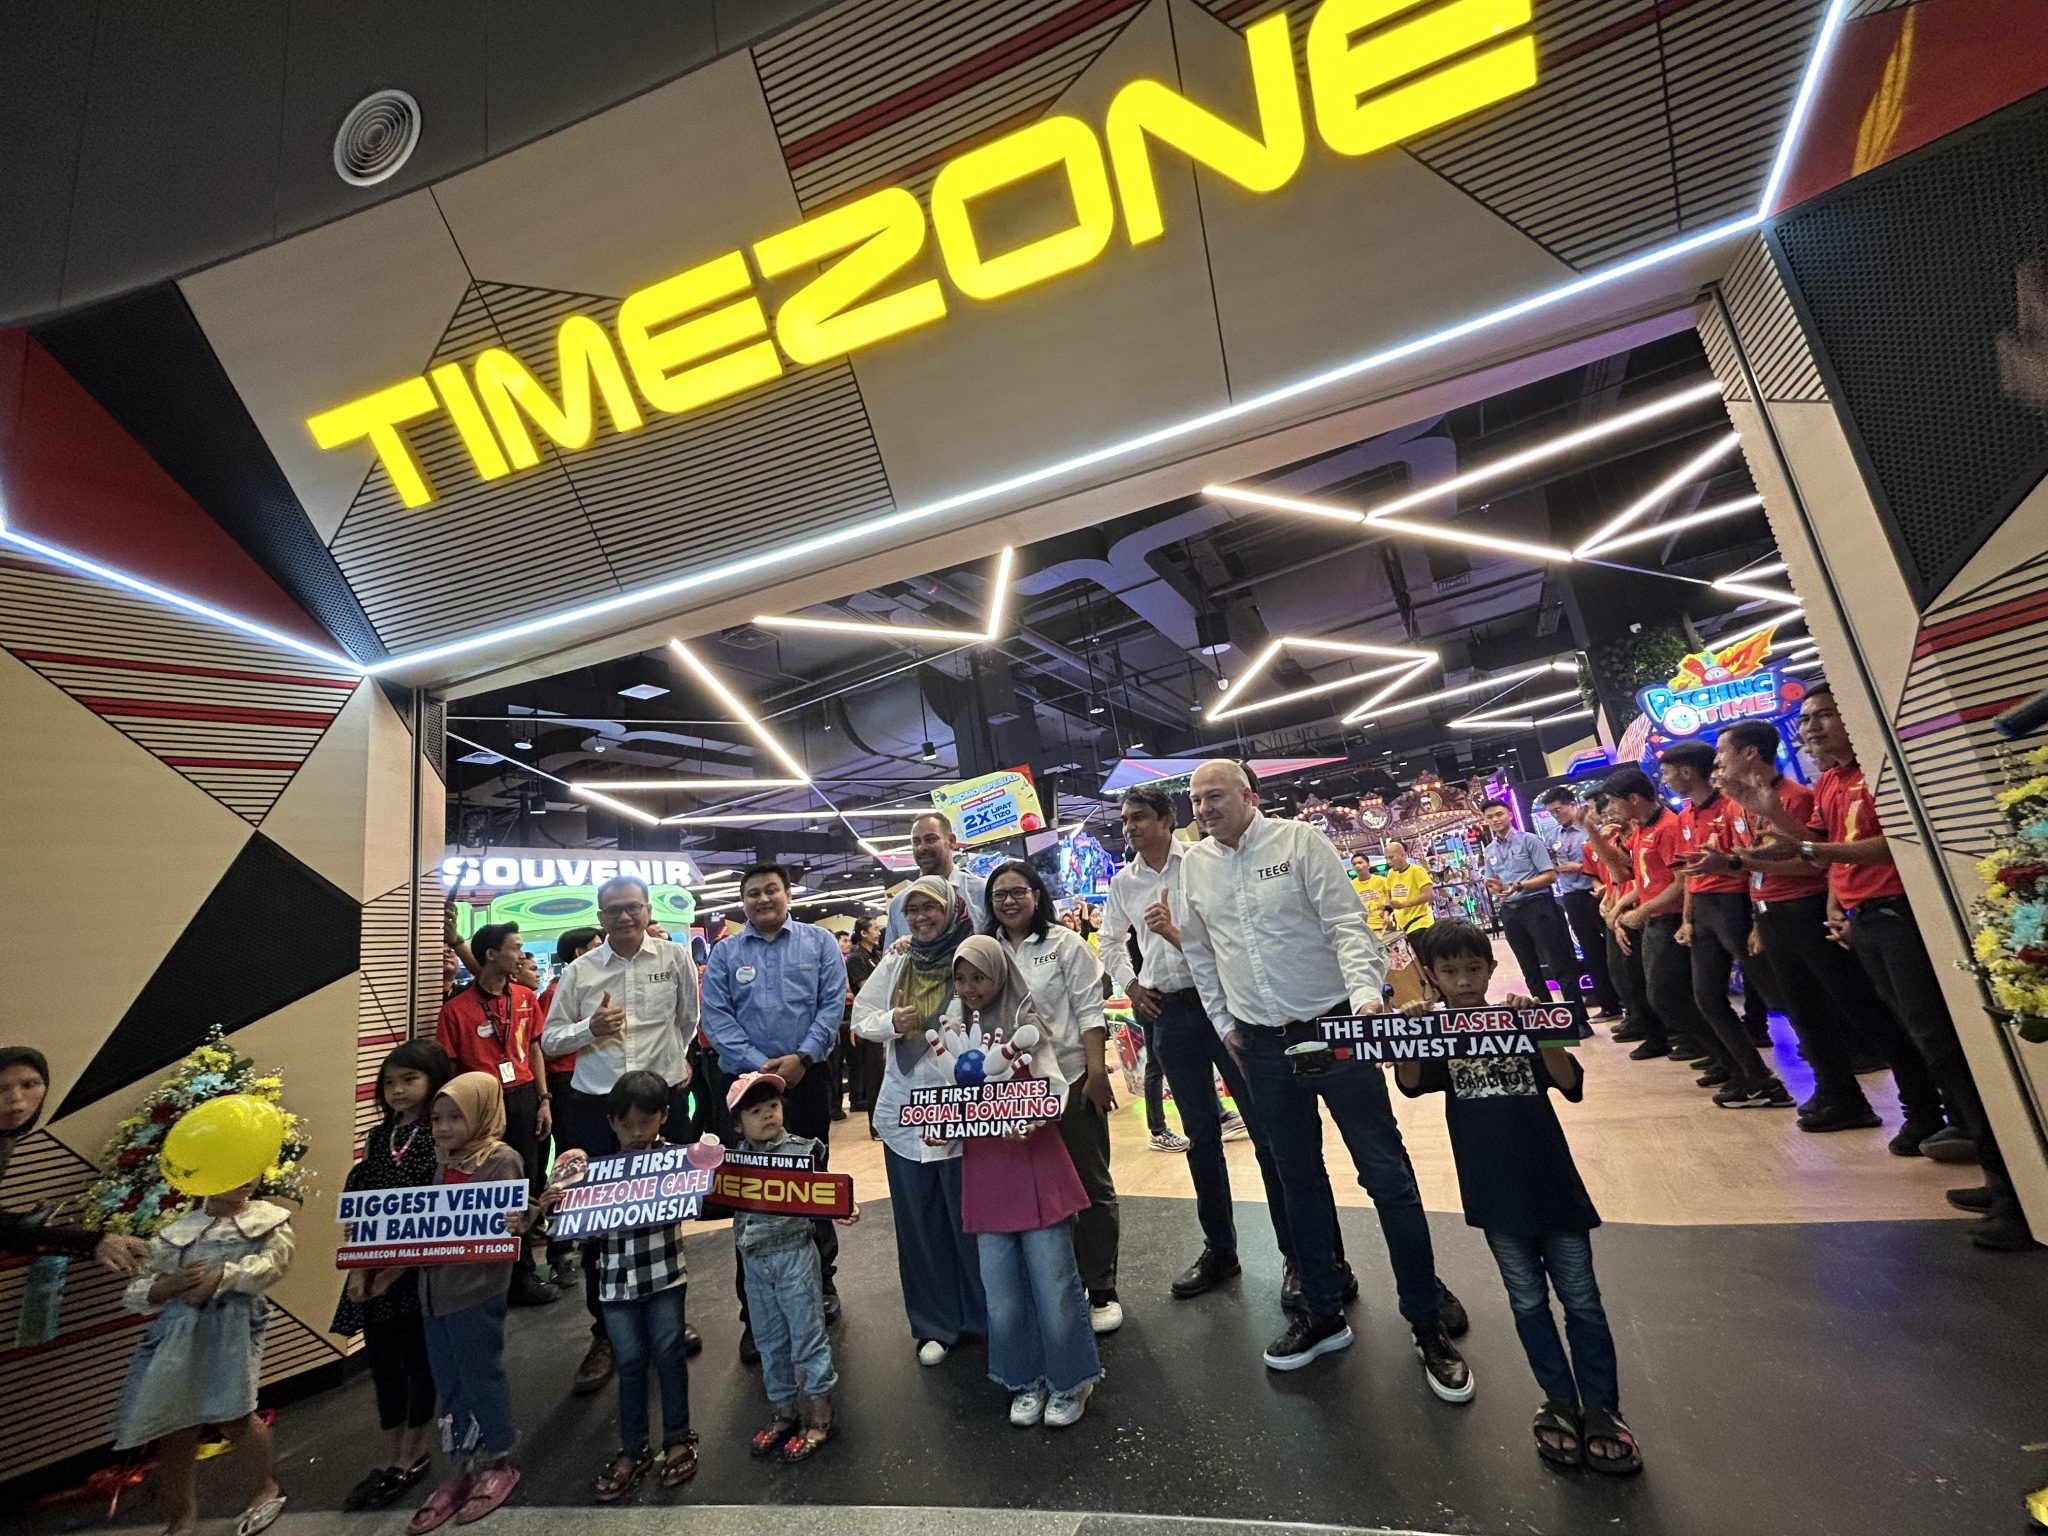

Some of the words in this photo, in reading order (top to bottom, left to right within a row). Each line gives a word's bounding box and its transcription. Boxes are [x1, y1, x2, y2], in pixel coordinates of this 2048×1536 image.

[305, 0, 1538, 508] TIMEZONE
[1702, 692, 1775, 722] TIME
[948, 787, 979, 806] PROMO
[980, 773, 1021, 793] SPESIAL
[963, 810, 992, 831] 2X
[991, 801, 1013, 815] LIPAT
[442, 856, 692, 887] SOUVENIR
[1257, 862, 1289, 879] TEEG
[1033, 951, 1056, 965] TEEG
[648, 971, 671, 982] TEEG
[1320, 1020, 1364, 1040] THE
[1372, 1016, 1434, 1037] FIRST
[1440, 1010, 1518, 1034] LASER
[1519, 1008, 1573, 1031] TAG
[1356, 1041, 1383, 1060] IN
[1390, 1037, 1458, 1059] WEST
[1466, 1034, 1536, 1057] JAVA
[912, 1090, 938, 1104] THE
[941, 1086, 980, 1102] FIRST
[982, 1084, 994, 1100] 8
[996, 1079, 1048, 1098] LANES
[901, 1103, 962, 1126] SOCIAL
[965, 1096, 1060, 1121] BOWLING
[924, 1124, 941, 1139] IN
[945, 1119, 1028, 1139] BANDUNG
[587, 1157, 625, 1182] THE
[631, 1148, 688, 1175] FIRST
[725, 1152, 769, 1167] ULTIMATE
[771, 1157, 793, 1169] FUN
[796, 1158, 810, 1169] AT
[340, 1190, 440, 1219] BIGGEST
[446, 1185, 524, 1211] VENUE
[553, 1175, 658, 1213] TIMEZONE
[660, 1169, 710, 1197] CAFE
[351, 1220, 378, 1243] IN
[386, 1212, 506, 1241] BANDUNG
[557, 1213, 583, 1236] IN
[586, 1196, 698, 1232] INDONESIA
[338, 1249, 397, 1261] SUMMARECON
[398, 1248, 421, 1258] MALL
[422, 1245, 465, 1257] BANDUNG
[485, 1243, 515, 1253] FLOOR
